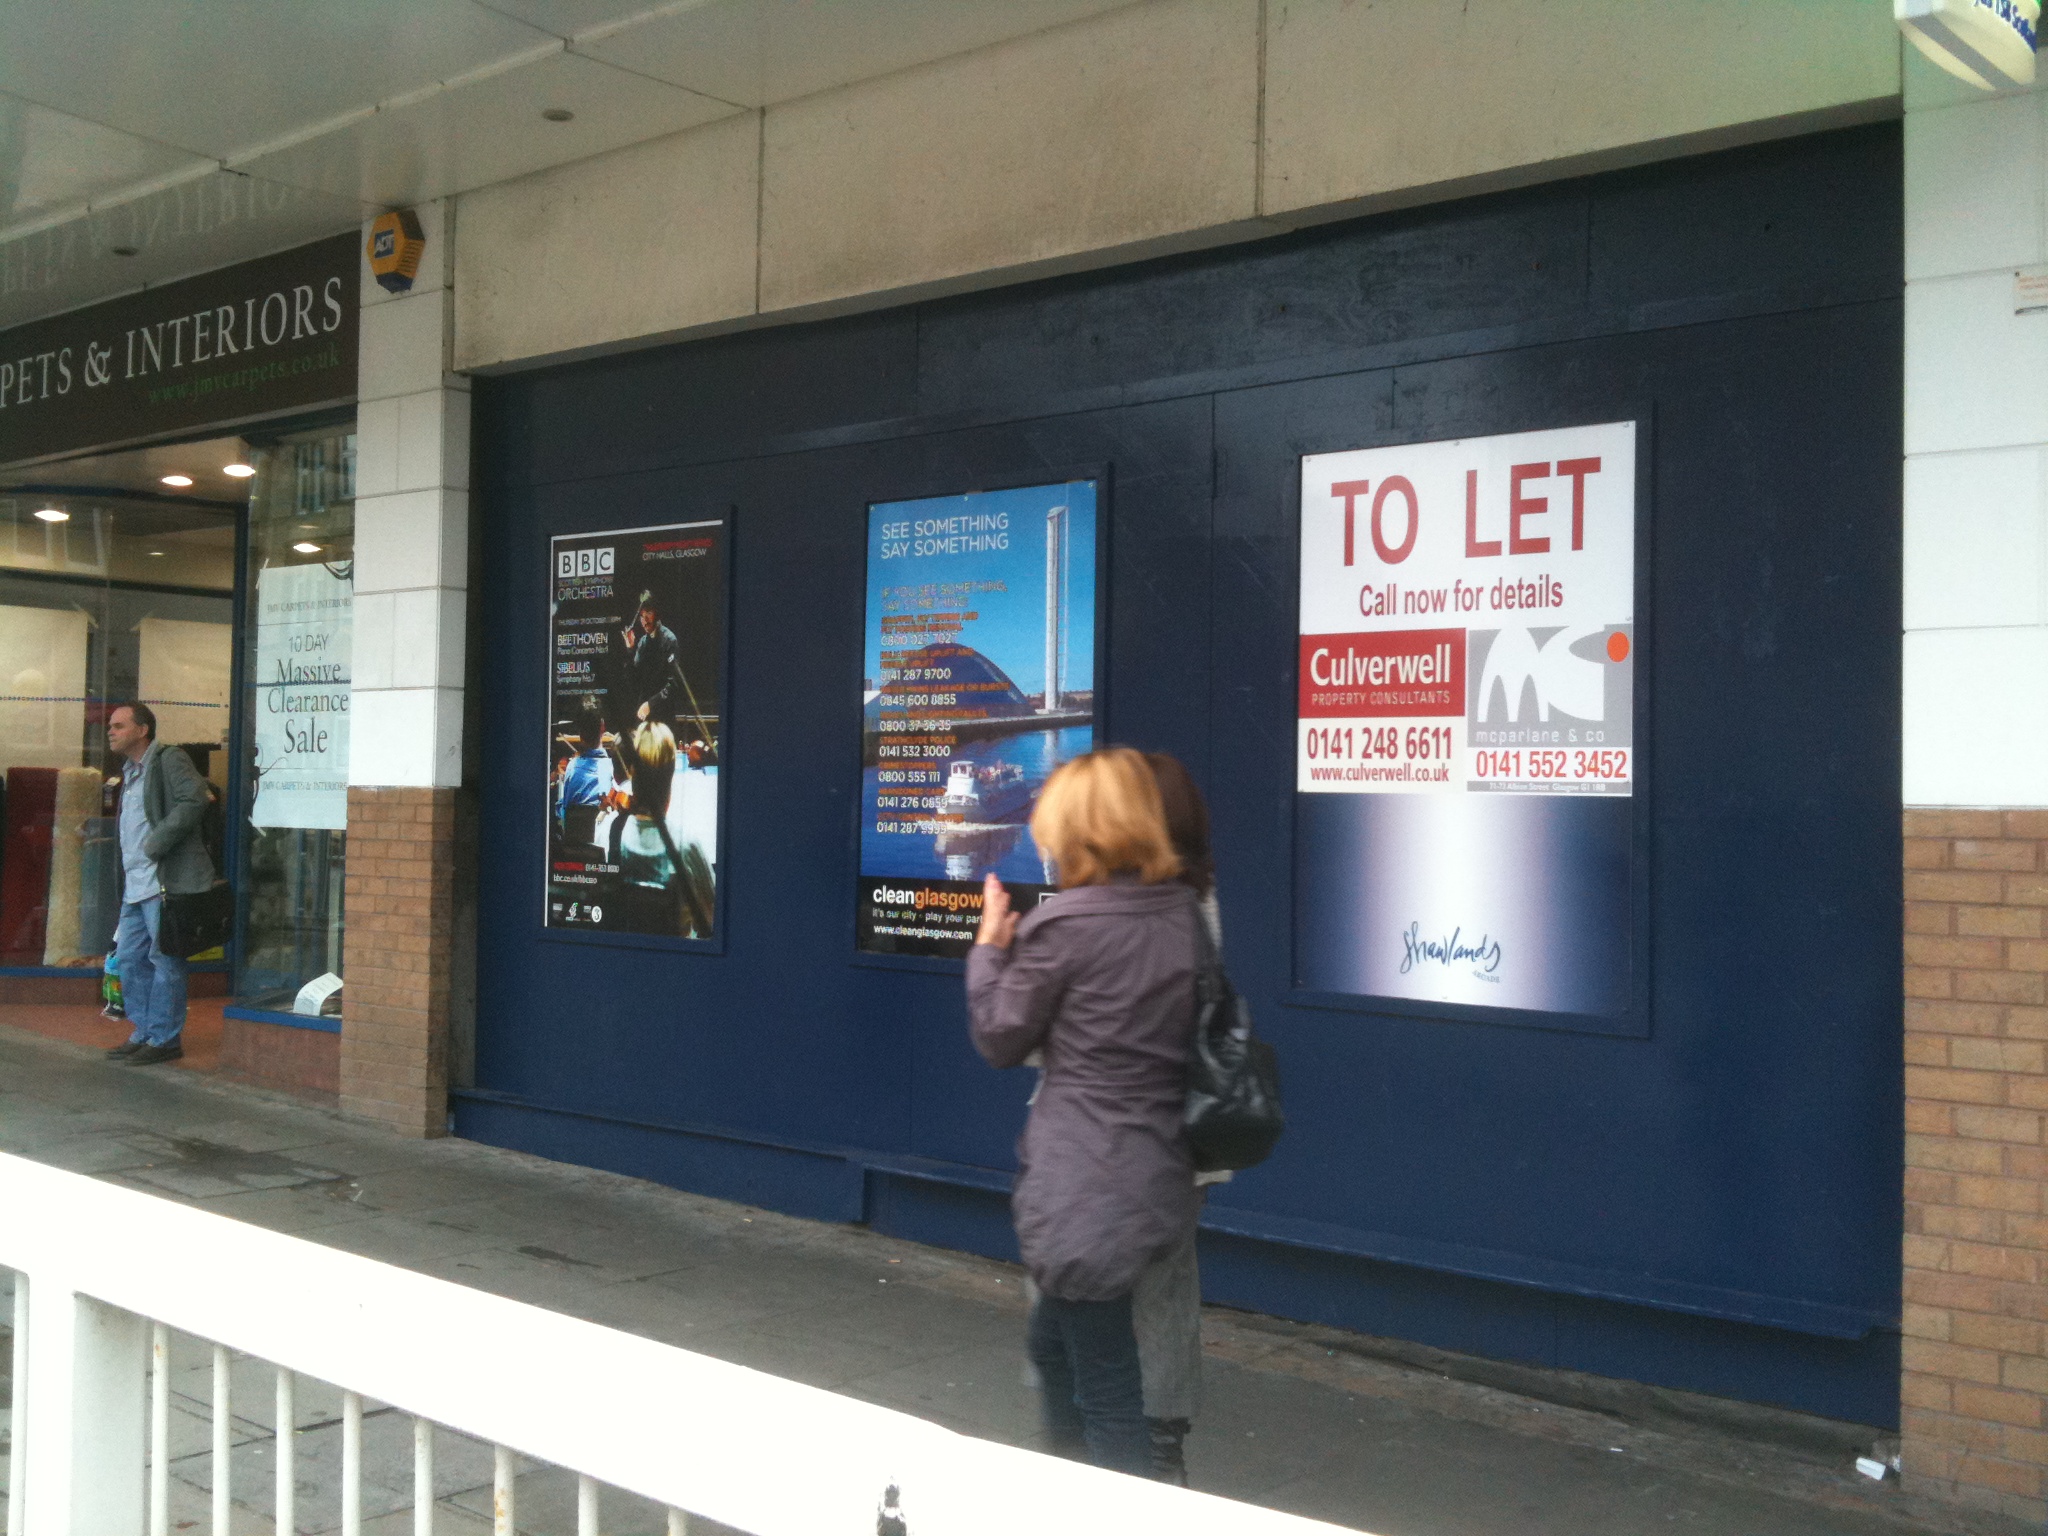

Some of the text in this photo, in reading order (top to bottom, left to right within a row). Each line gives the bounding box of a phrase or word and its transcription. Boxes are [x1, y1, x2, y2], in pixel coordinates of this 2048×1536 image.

[375, 234, 394, 252] ADT
[84, 341, 112, 387] &
[125, 277, 342, 378] INTERIORS
[1331, 457, 1602, 566] TO LET
[882, 512, 1009, 540] SEE SOMETHING
[881, 533, 1009, 559] SAY SOMETHING
[560, 549, 613, 576] BBC
[558, 585, 614, 601] ORCHESTRA
[1359, 574, 1563, 617] Call now for details
[289, 634, 331, 652] 10 DAY
[558, 632, 608, 646] BEETHOVEN
[277, 656, 341, 683] Massive
[557, 661, 590, 673] SIBELIUS
[1310, 644, 1450, 686] Culverwell
[880, 668, 951, 681] 0141 287 9700
[268, 688, 348, 713] Clearance
[880, 695, 905, 706] 0845
[907, 694, 929, 706] 600
[1311, 690, 1450, 706] PROPERTY CONSULTANTS
[284, 716, 328, 753] Sale
[880, 721, 906, 732] 0800
[1307, 727, 1452, 759] 0141 248 6611
[1476, 728, 1605, 745] mcparlane & co
[879, 745, 951, 757] 0141 532 3000
[1310, 763, 1450, 782] www.culverwell.co.uk
[1476, 750, 1627, 778] 0141 552 3452
[878, 771, 940, 783] 0800 555 111
[877, 797, 898, 808] 0141
[900, 797, 919, 808] 276
[876, 822, 898, 833] 0141
[900, 823, 917, 834] 287
[873, 885, 984, 911] cleanglasgow
[925, 911, 942, 923] play
[945, 913, 963, 923] your
[873, 925, 973, 940] www.cleanglasgow.com
